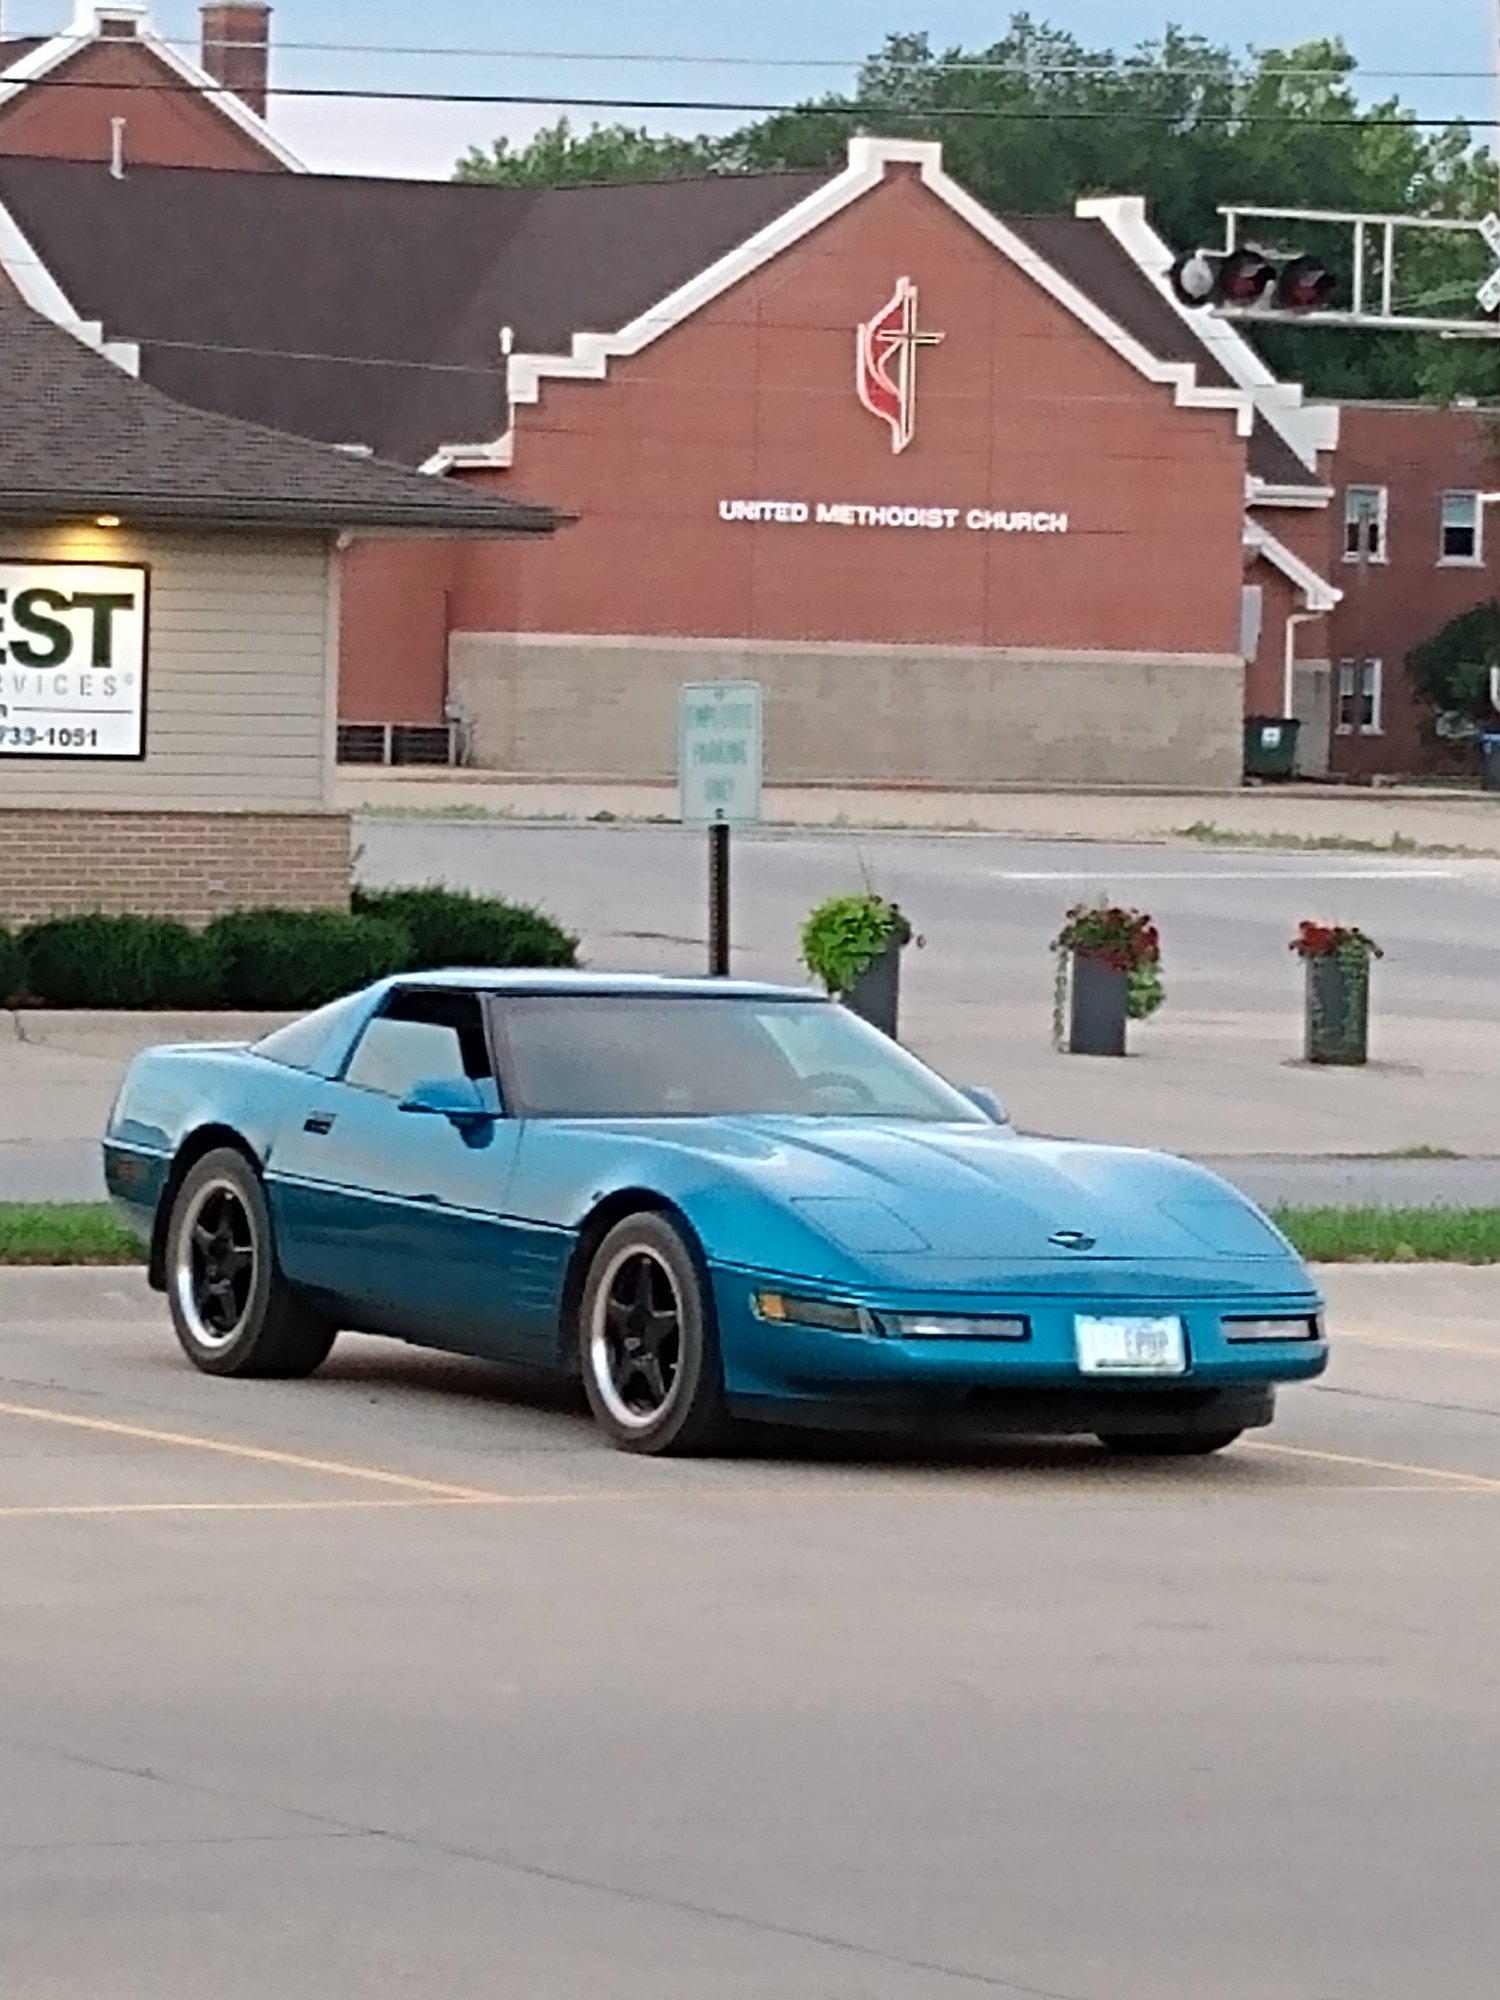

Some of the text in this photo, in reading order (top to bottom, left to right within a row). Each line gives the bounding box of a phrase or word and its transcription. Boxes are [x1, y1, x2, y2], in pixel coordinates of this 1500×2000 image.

[719, 500, 1068, 532] UNITED METHODIST CHURCH
[0, 587, 135, 669] ST
